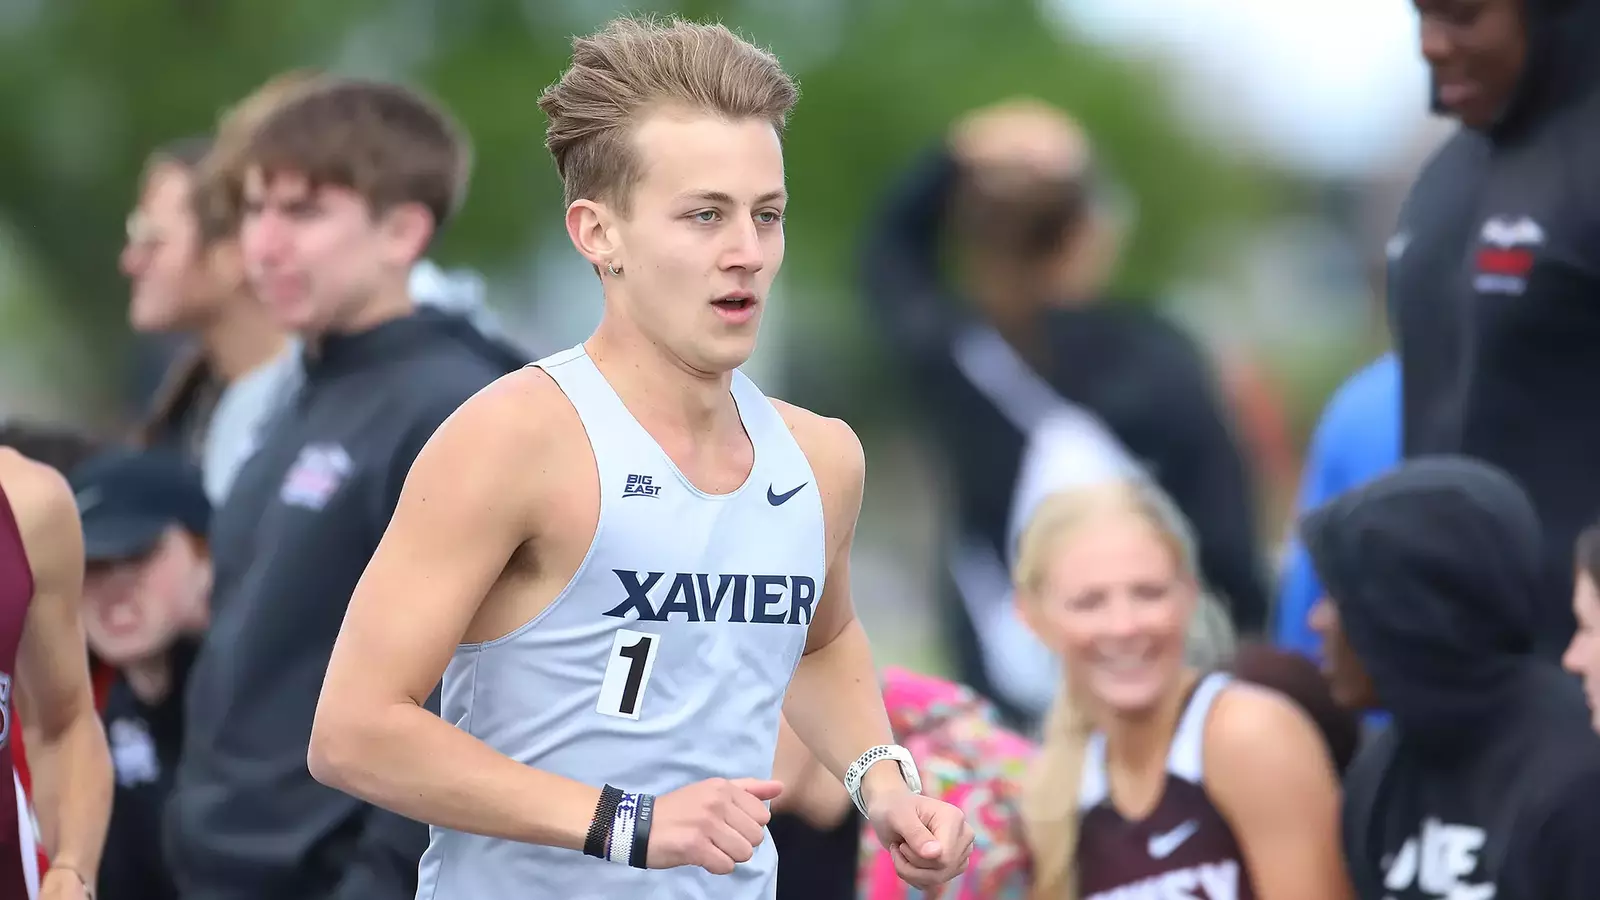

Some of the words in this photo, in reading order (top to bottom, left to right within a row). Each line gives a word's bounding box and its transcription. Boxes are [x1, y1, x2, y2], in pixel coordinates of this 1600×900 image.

[623, 483, 662, 495] EAST
[626, 474, 653, 485] BIG
[601, 568, 816, 626] XAVIER
[618, 636, 652, 715] 1
